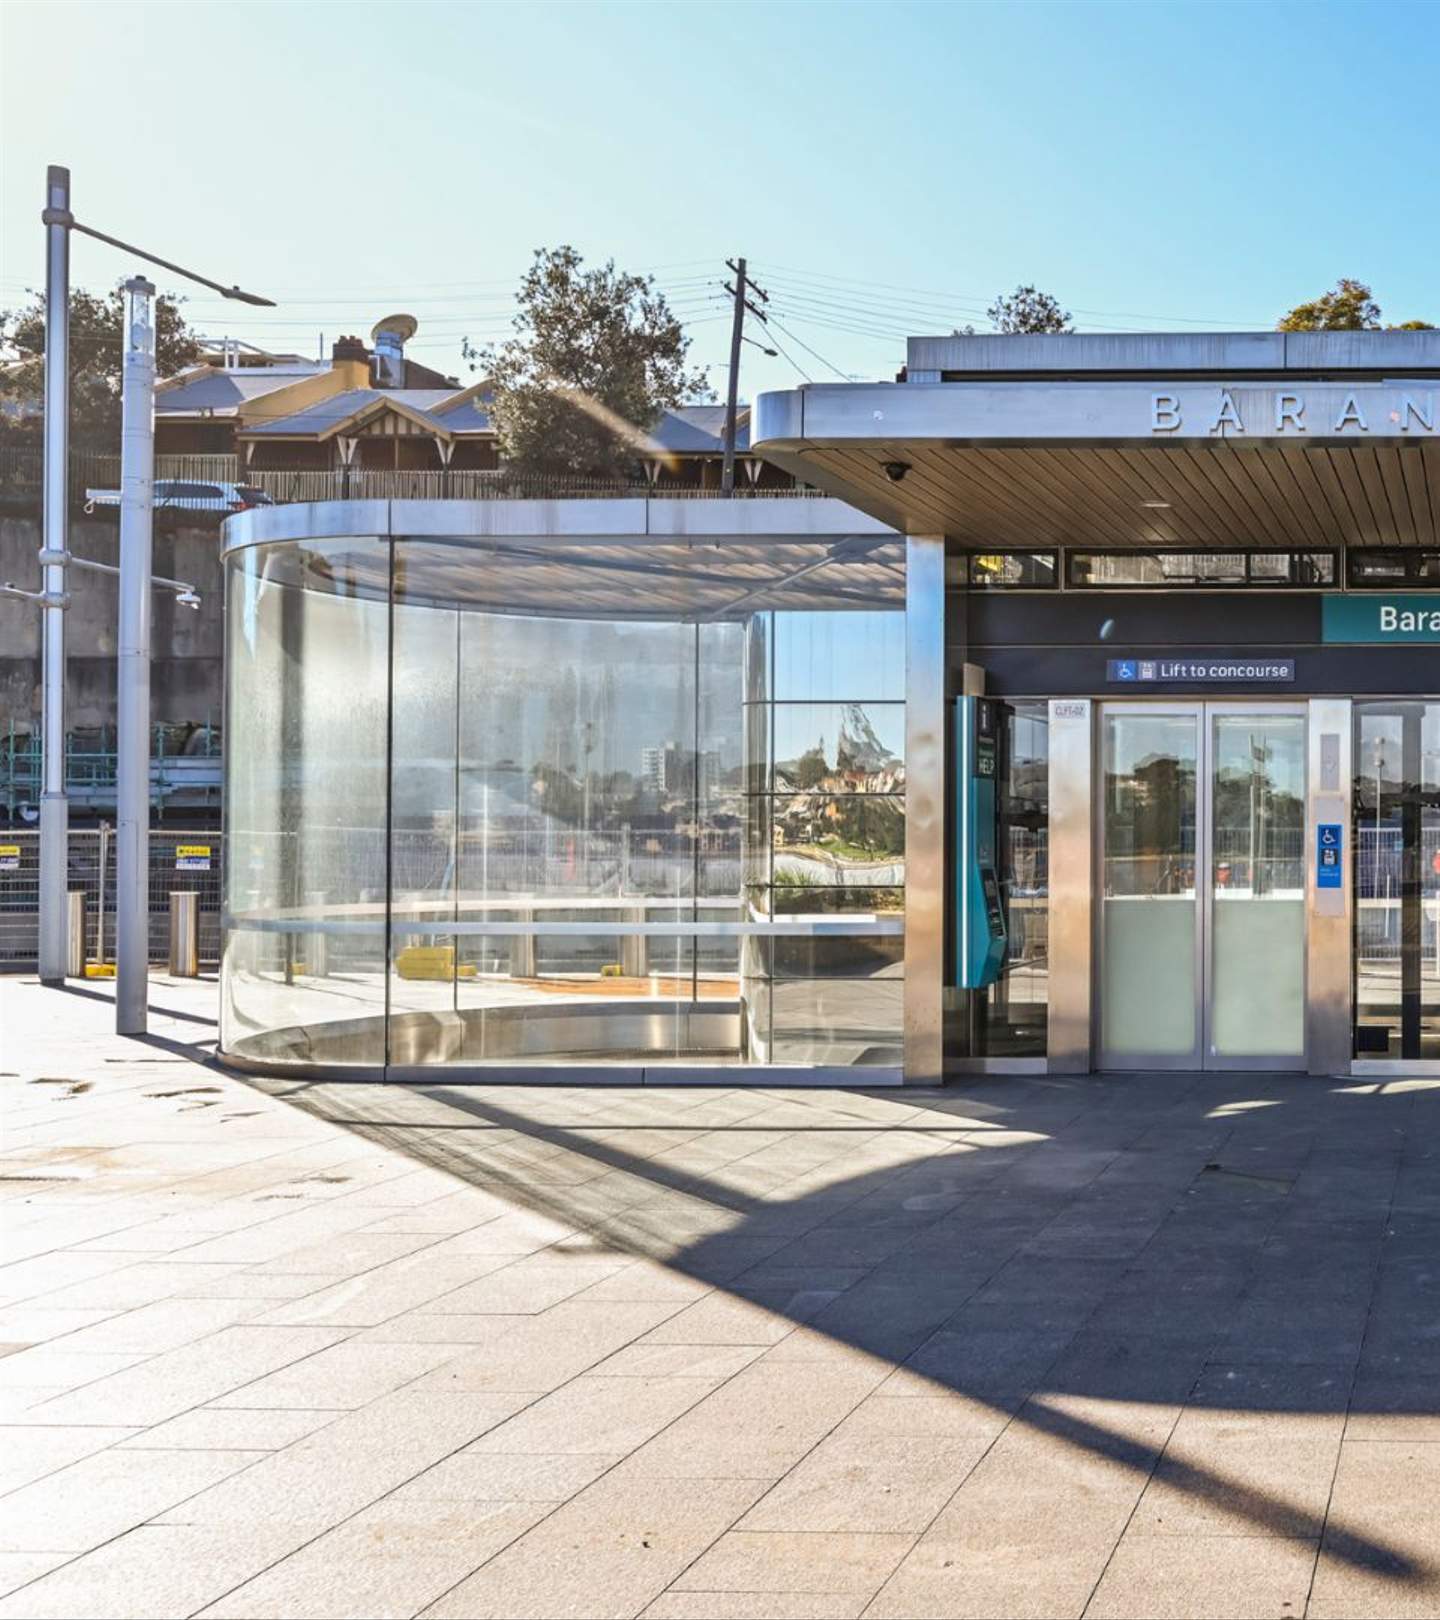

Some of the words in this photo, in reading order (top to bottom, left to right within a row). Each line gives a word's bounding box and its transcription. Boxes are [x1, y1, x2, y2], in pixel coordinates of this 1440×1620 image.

[1161, 663, 1187, 677] Lift
[1190, 665, 1206, 677] to
[1209, 665, 1288, 678] concourse
